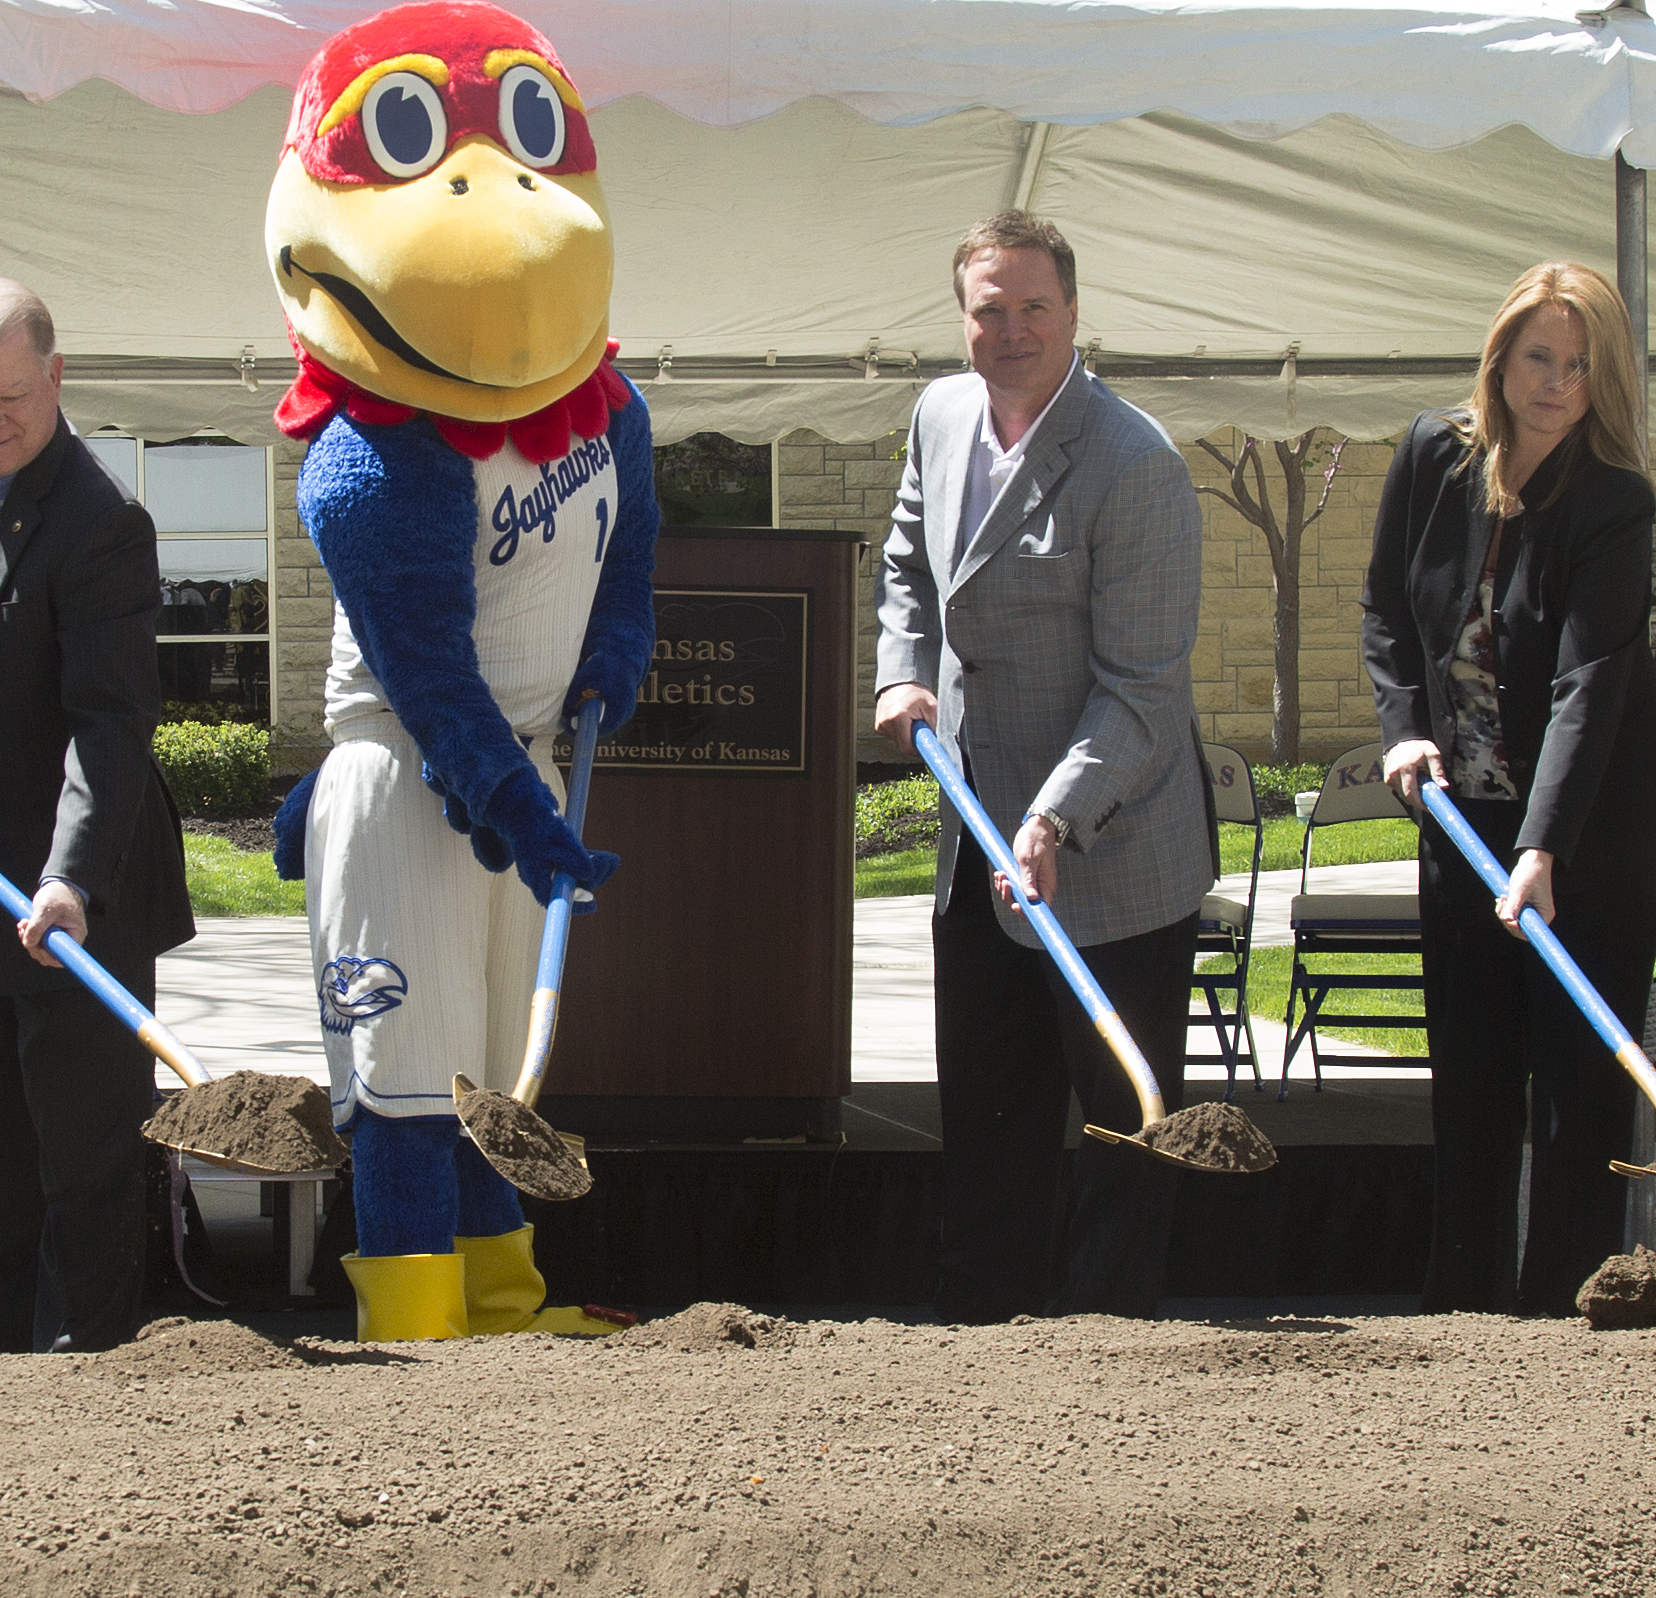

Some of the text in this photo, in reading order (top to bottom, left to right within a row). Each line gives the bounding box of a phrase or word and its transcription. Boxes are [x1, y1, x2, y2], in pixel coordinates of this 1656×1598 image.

[489, 436, 610, 566] Jayhawks
[595, 497, 608, 562] 1
[651, 639, 735, 661] nsas
[636, 670, 755, 705] letics
[597, 740, 686, 762] niversity
[692, 741, 714, 759] of
[719, 742, 790, 761] Kansas
